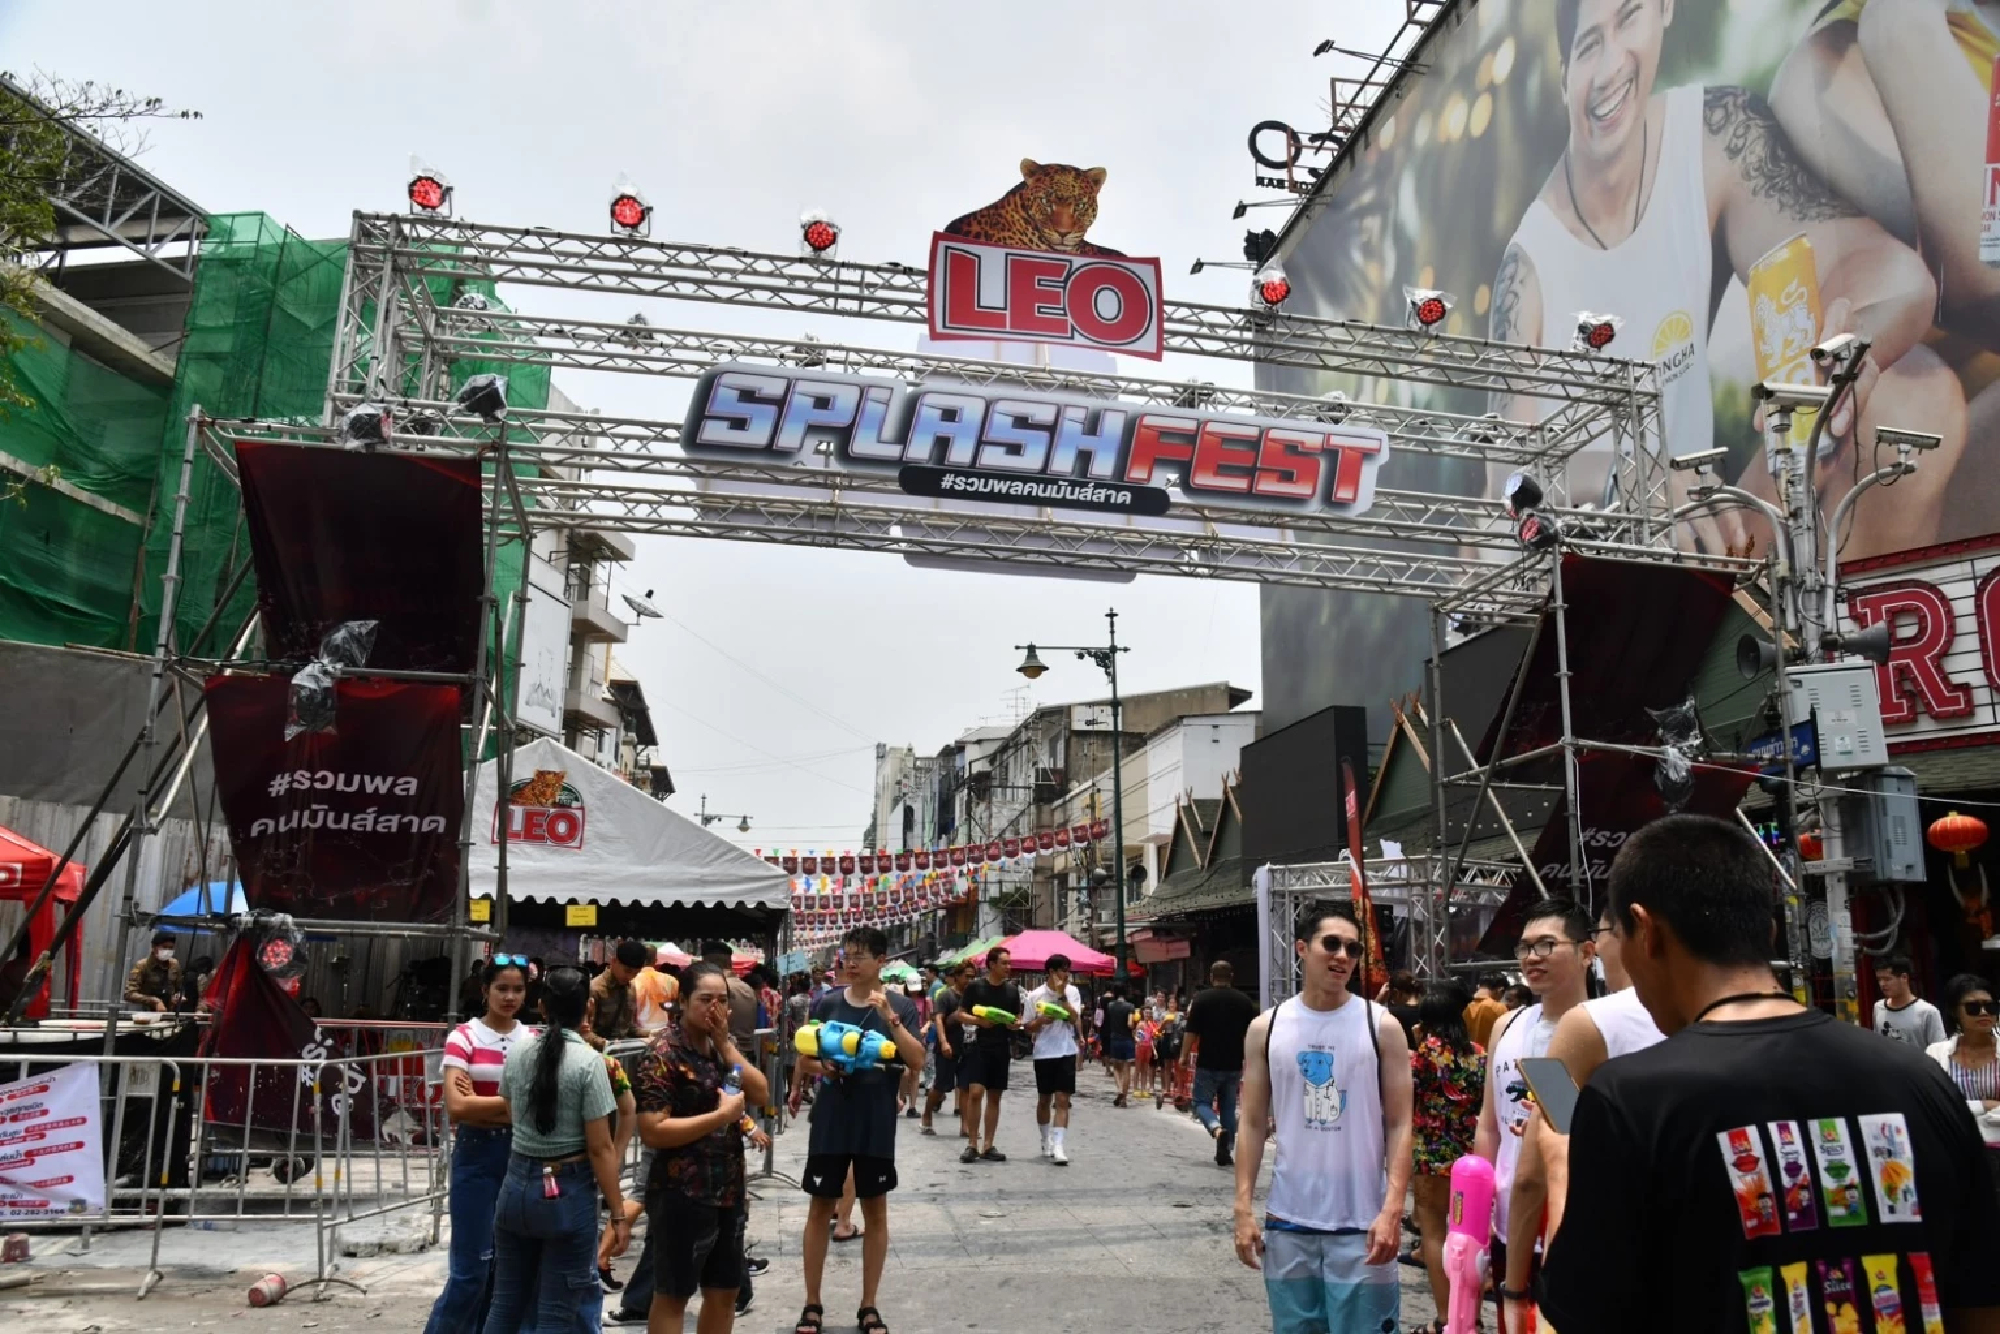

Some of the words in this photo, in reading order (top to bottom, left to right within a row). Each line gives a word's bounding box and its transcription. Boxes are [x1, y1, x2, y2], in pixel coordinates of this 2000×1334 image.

[944, 246, 1152, 345] LEO
[1657, 343, 1695, 377] INGHA
[697, 371, 1128, 479] SPLASH
[1124, 413, 1383, 504] FEST
[941, 473, 1131, 504] #รวมพลคนมันส์สาด
[1848, 577, 2000, 724] R
[268, 770, 418, 797] #รวมพล
[250, 804, 447, 837] คนมันส์สาด
[497, 808, 581, 844] LEO
